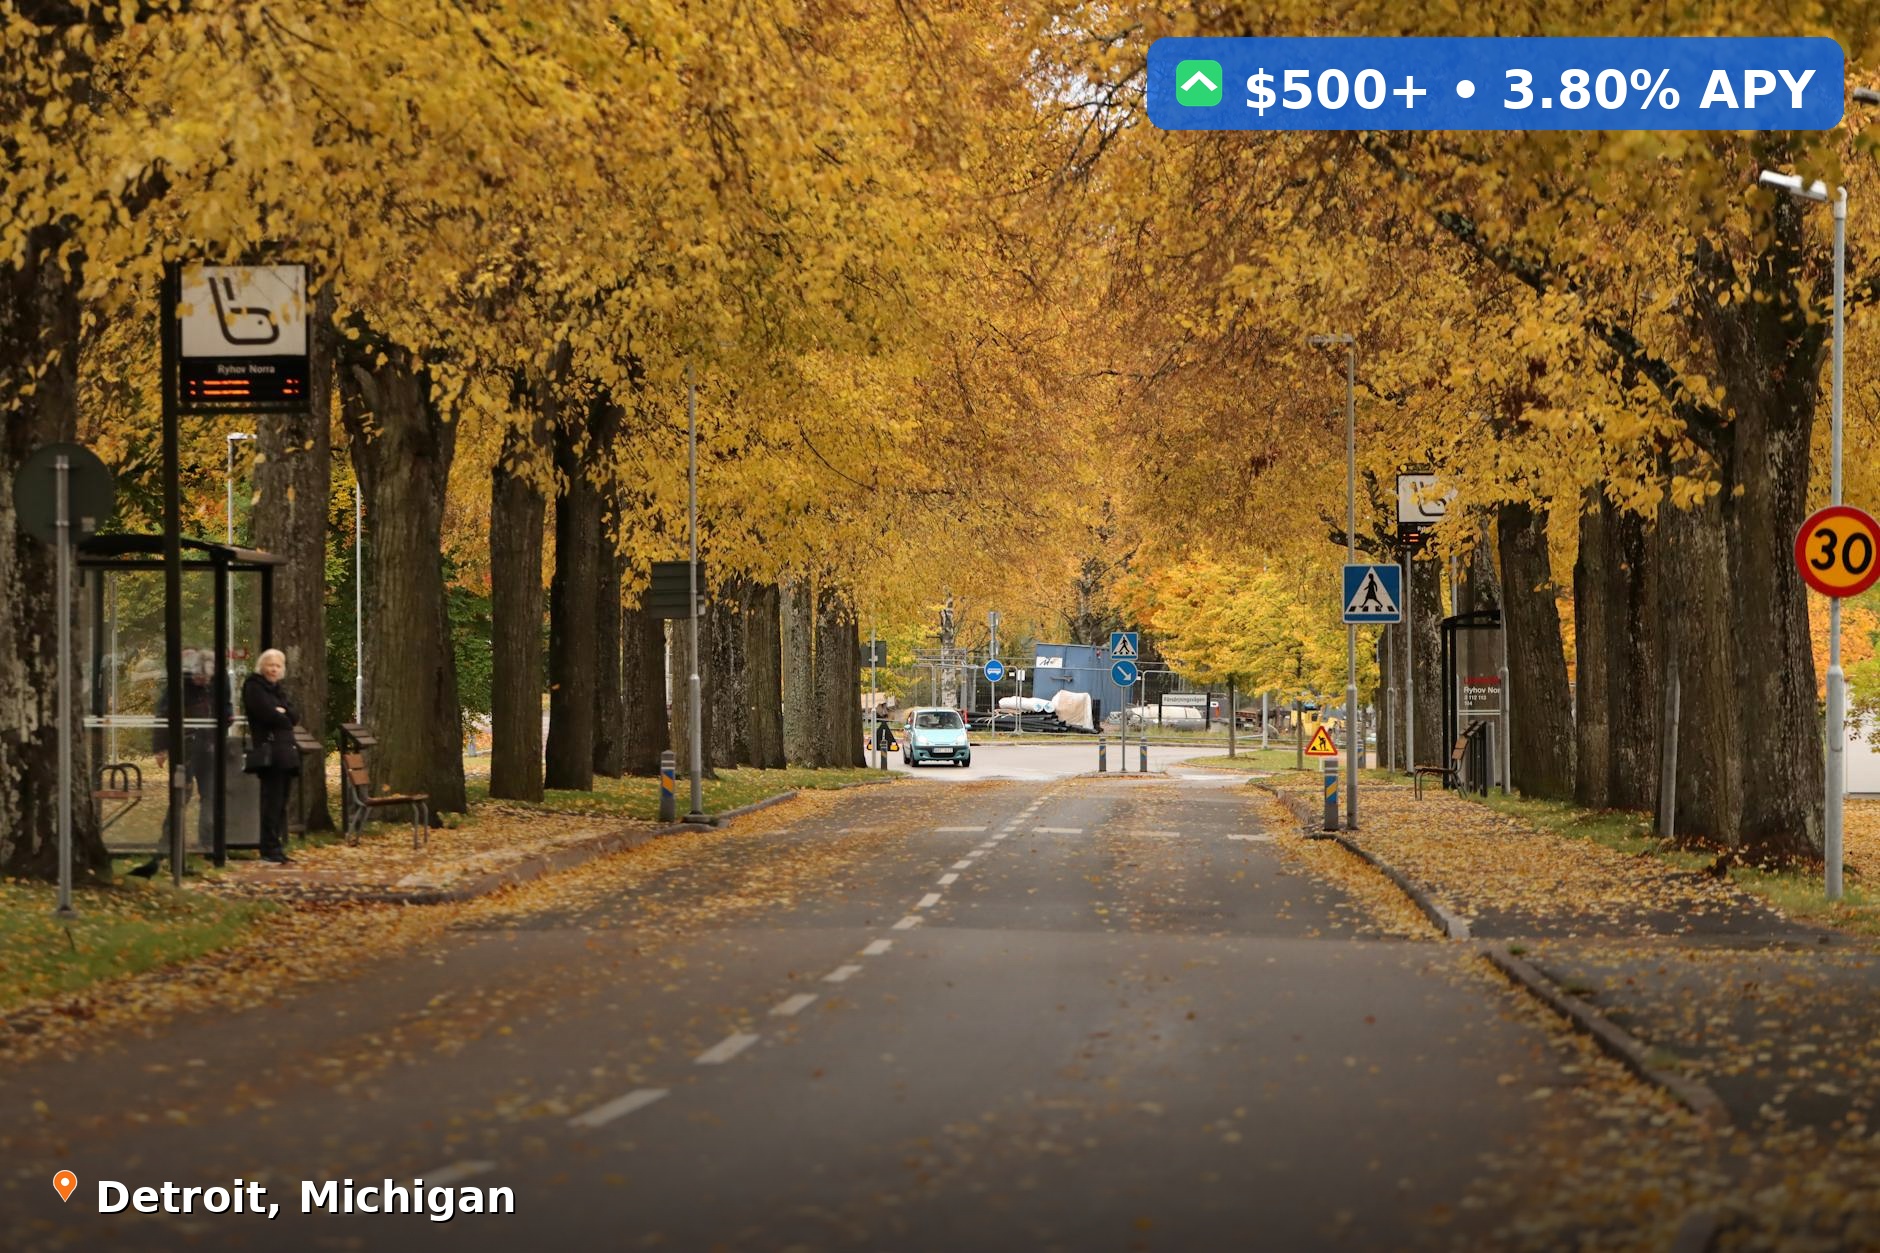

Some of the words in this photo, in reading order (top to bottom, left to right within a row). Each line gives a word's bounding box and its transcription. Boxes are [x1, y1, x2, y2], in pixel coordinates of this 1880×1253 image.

[217, 364, 246, 375] Ryhov
[249, 364, 275, 374] Norra
[1811, 528, 1873, 576] 30
[1463, 686, 1486, 694] Ryhov
